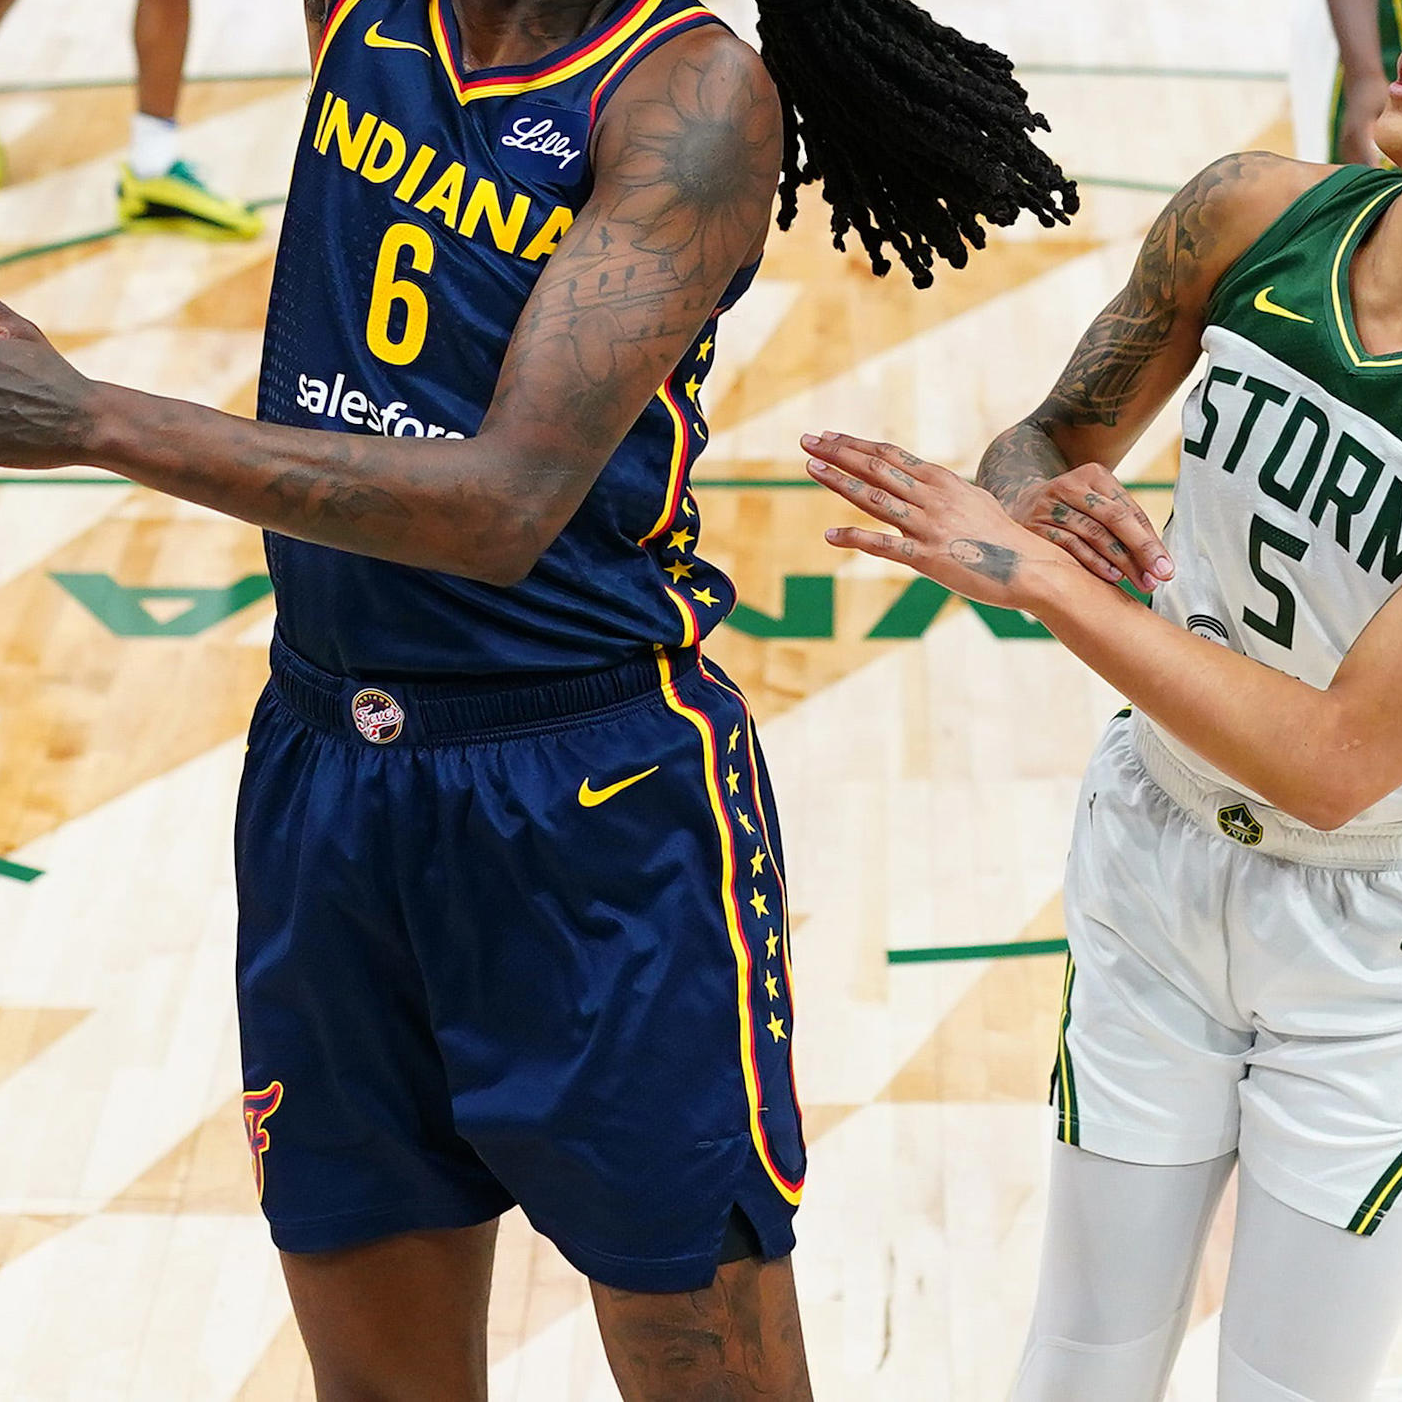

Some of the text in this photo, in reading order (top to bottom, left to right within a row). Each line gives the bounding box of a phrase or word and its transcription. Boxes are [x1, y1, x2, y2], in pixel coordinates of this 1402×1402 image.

[313, 91, 576, 262] INDIANA
[501, 117, 581, 170] Lilly
[366, 223, 435, 366] 6
[1243, 513, 1310, 651] 5
